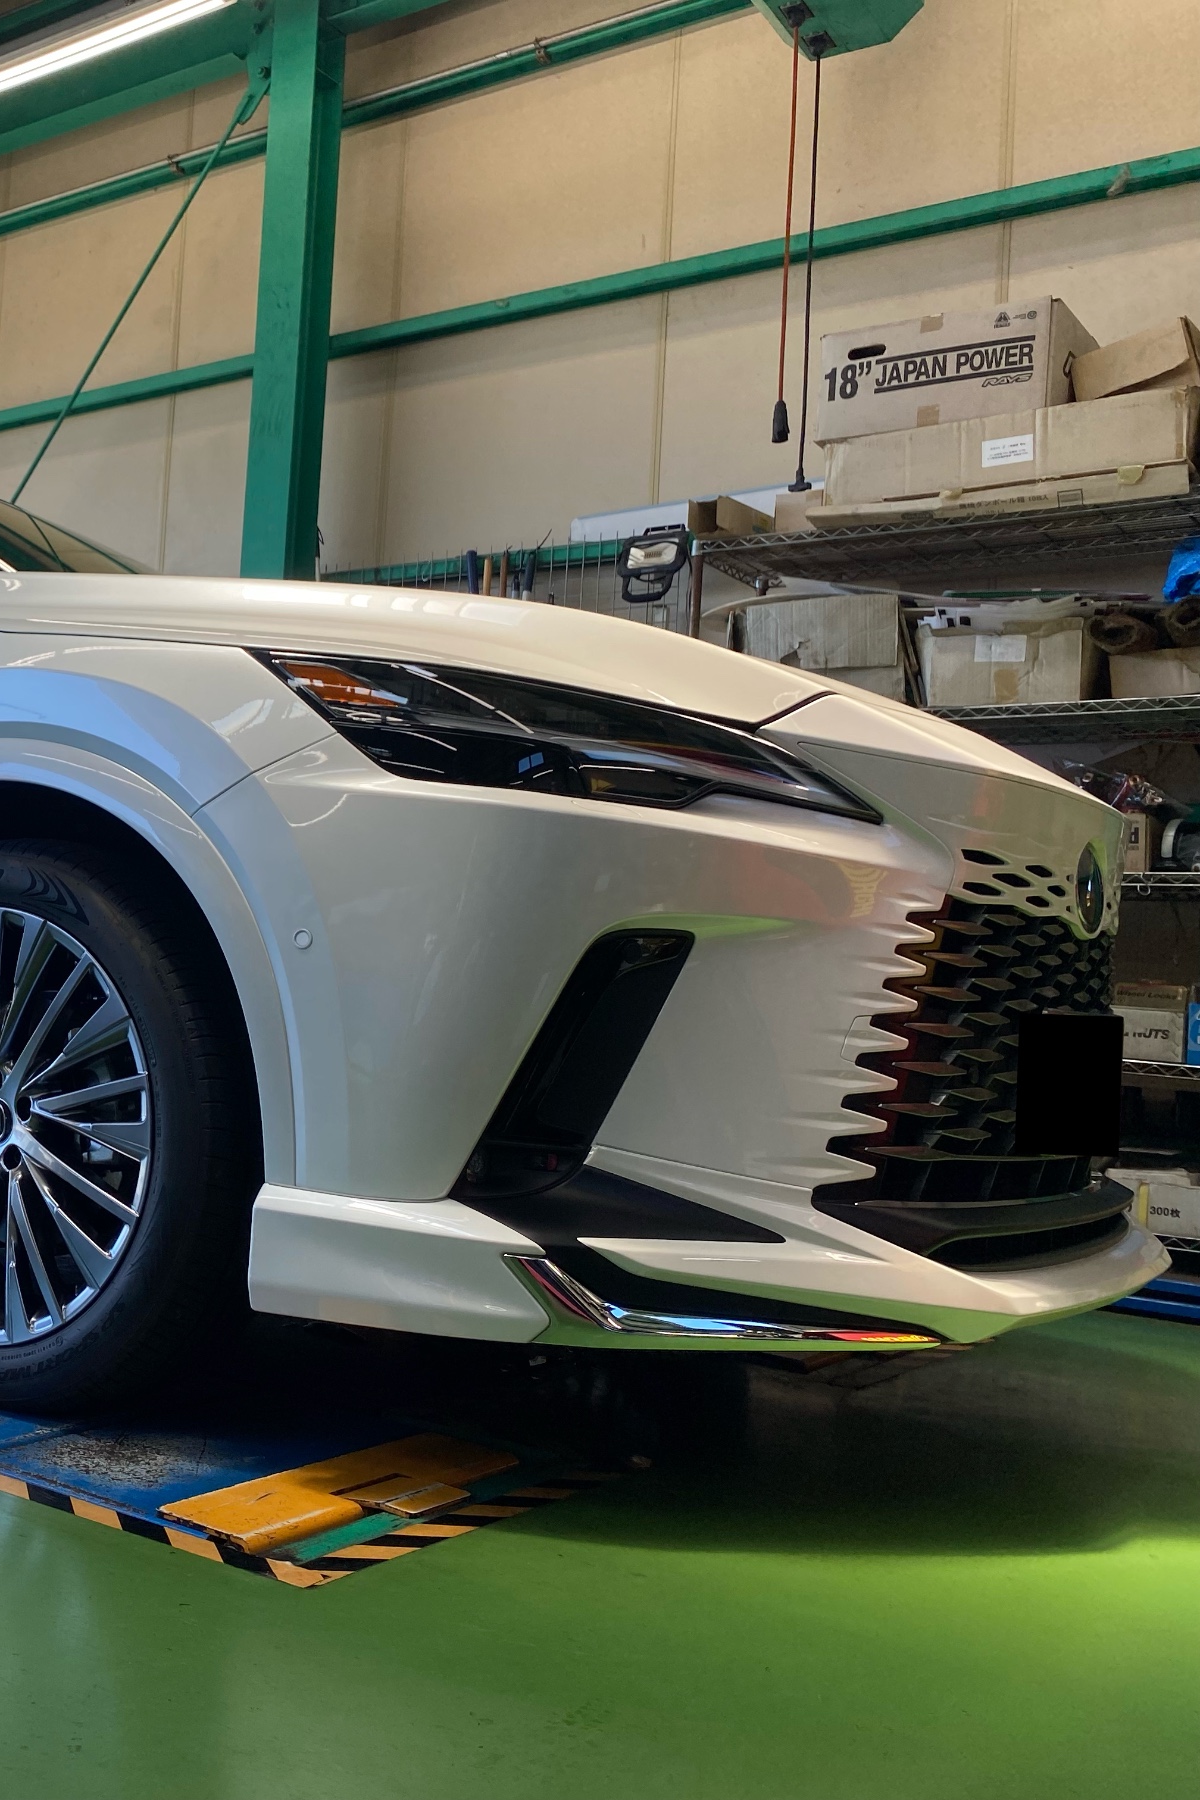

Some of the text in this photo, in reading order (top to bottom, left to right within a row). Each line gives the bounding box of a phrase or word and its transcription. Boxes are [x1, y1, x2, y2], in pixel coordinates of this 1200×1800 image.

[875, 355, 947, 387] JAPAN
[955, 343, 1034, 374] POWER
[982, 373, 1033, 387] RAYS
[1149, 1205, 1181, 1219] 300枚
